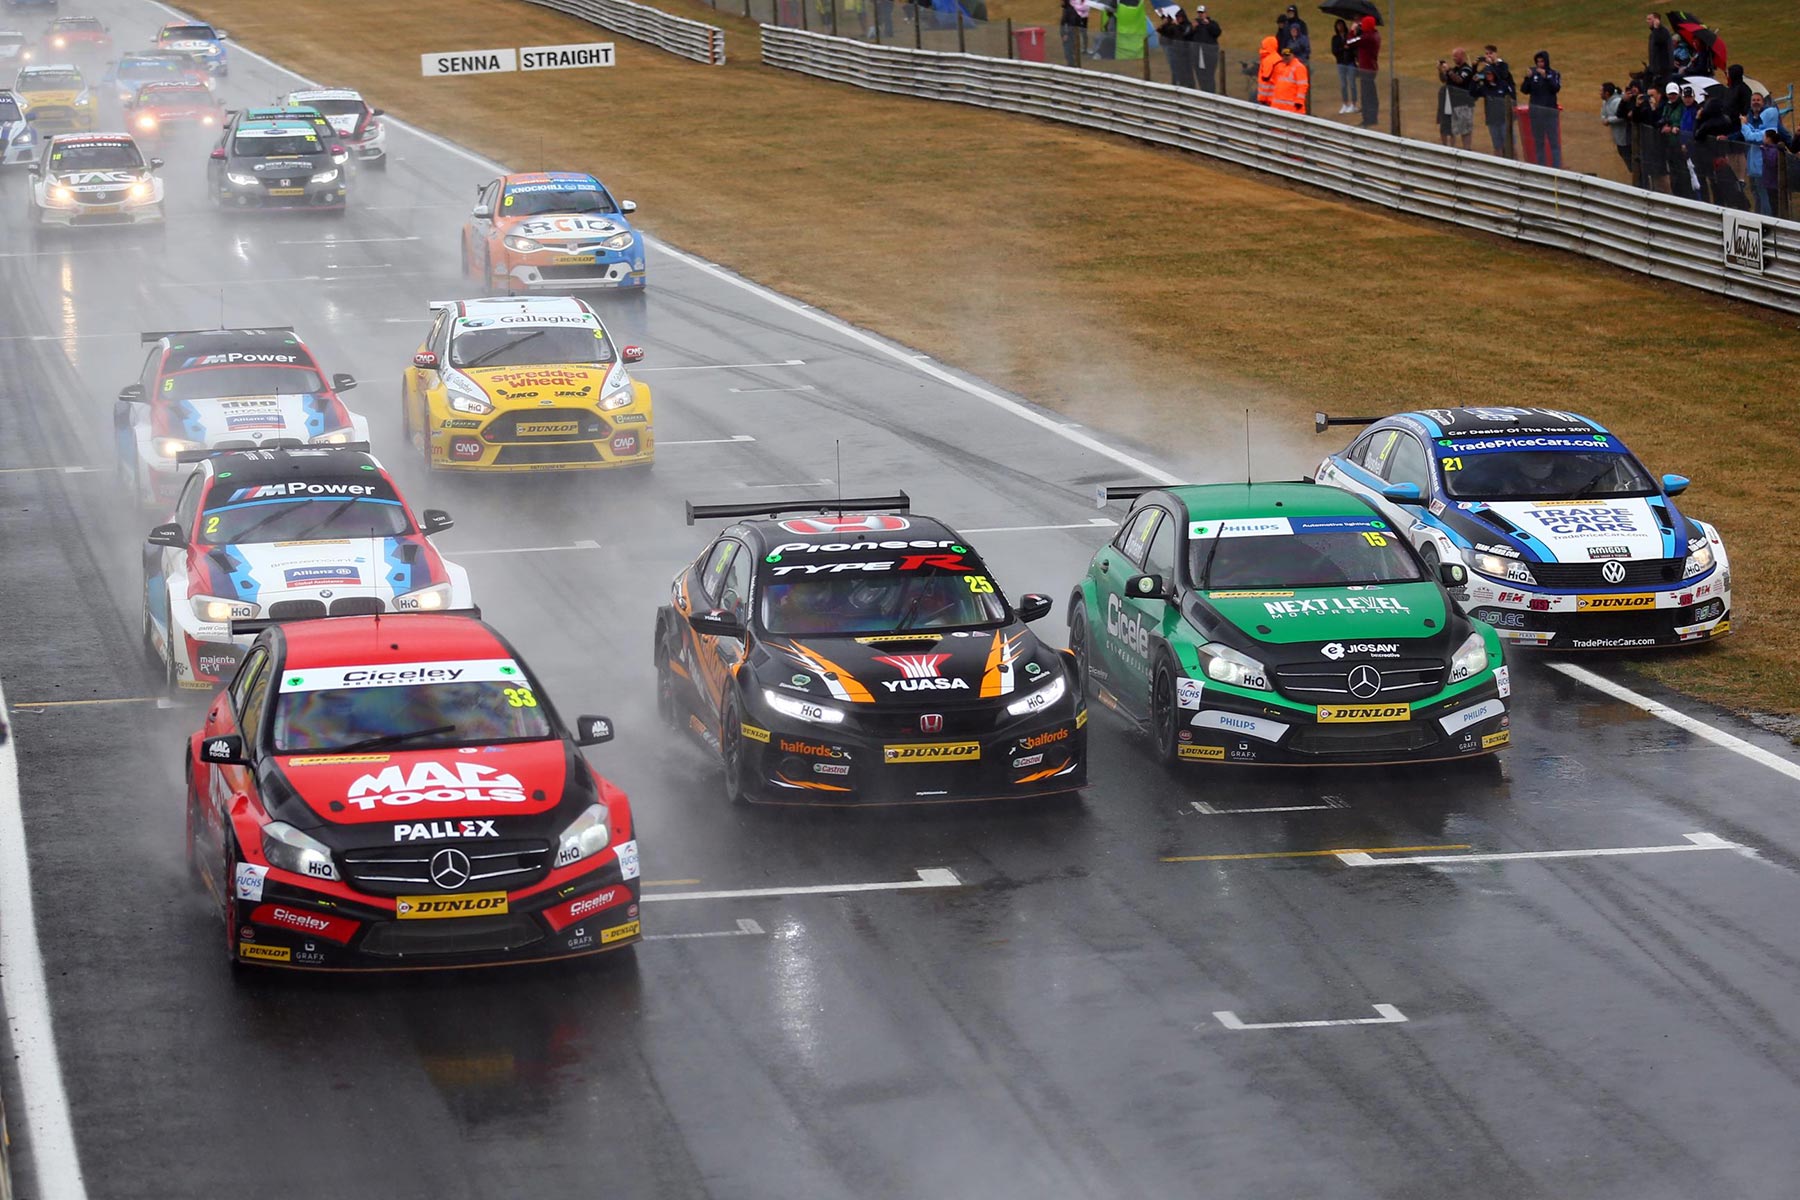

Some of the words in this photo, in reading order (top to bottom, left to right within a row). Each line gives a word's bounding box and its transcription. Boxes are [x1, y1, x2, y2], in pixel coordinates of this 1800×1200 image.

[438, 55, 500, 73] SENNA
[523, 48, 612, 68] STRAIGHT
[512, 184, 564, 193] KNOCKHILL
[504, 196, 514, 206] 6
[500, 315, 588, 324] Gallagher
[593, 329, 603, 339] 3
[164, 379, 174, 391] 5
[468, 404, 481, 412] HiQ
[526, 424, 578, 433] DUNLOP
[456, 443, 480, 455] CMP
[614, 437, 635, 449] CMP
[1449, 437, 1609, 452] TradePriceCars.com
[1442, 457, 1463, 471] 21
[1524, 508, 1633, 519] TRADE
[206, 517, 220, 533] 2
[1539, 515, 1634, 527] PRICE
[1551, 523, 1638, 534] CARS
[1361, 532, 1388, 547] 15
[769, 540, 955, 556] Pioneer
[1589, 546, 1629, 554] AMIGOS
[772, 561, 895, 576] TYPE
[899, 554, 975, 571] R
[1687, 564, 1700, 575] HiQ
[292, 569, 335, 577] Allianz
[1508, 570, 1527, 581] HiQ
[964, 576, 994, 593] 25
[401, 599, 419, 608] HiQ
[1264, 600, 1330, 615] NEXT
[1333, 596, 1409, 611] LEVEL
[1591, 598, 1655, 607] DUNLOP
[231, 608, 251, 617] HiQ
[1271, 609, 1411, 620] MOTORSPORT
[1478, 610, 1525, 627] ROLEC
[1347, 644, 1397, 653] JIGSAW
[1572, 638, 1656, 648] TradePriceCars.com
[200, 656, 236, 664] majenta
[343, 668, 463, 682] Ciceley
[1452, 667, 1468, 680] HiQ
[881, 678, 970, 692] YUASA
[1243, 674, 1265, 687] HiQ
[503, 688, 537, 708] 33
[1177, 688, 1201, 699] FUCHS
[1027, 695, 1045, 709] HiQ
[801, 705, 822, 719] HiQ
[1335, 708, 1407, 718] DUNLOP
[1463, 706, 1487, 722] PHILIPS
[1220, 717, 1255, 730] PHILIPS
[743, 728, 768, 738] DUNLOP
[1027, 728, 1069, 748] halfords
[209, 740, 230, 753] MAC
[781, 740, 831, 757] halfords
[901, 746, 978, 757] DUNLOP
[1186, 748, 1222, 756] DUNLOP
[1459, 742, 1477, 750] GRAFX
[822, 766, 847, 774] Castrol
[347, 762, 525, 798] MAC
[348, 788, 527, 810] TOOLS
[560, 847, 580, 862] HiQ
[309, 861, 332, 876] HiQ
[237, 876, 261, 887] FUCHS
[416, 898, 506, 912] DUNLOP
[570, 890, 615, 913] Ciceley
[274, 908, 330, 930] Ciceley
[568, 936, 593, 947] GRAFX
[249, 947, 288, 957] DUNLOP
[296, 951, 325, 960] GRAFX
